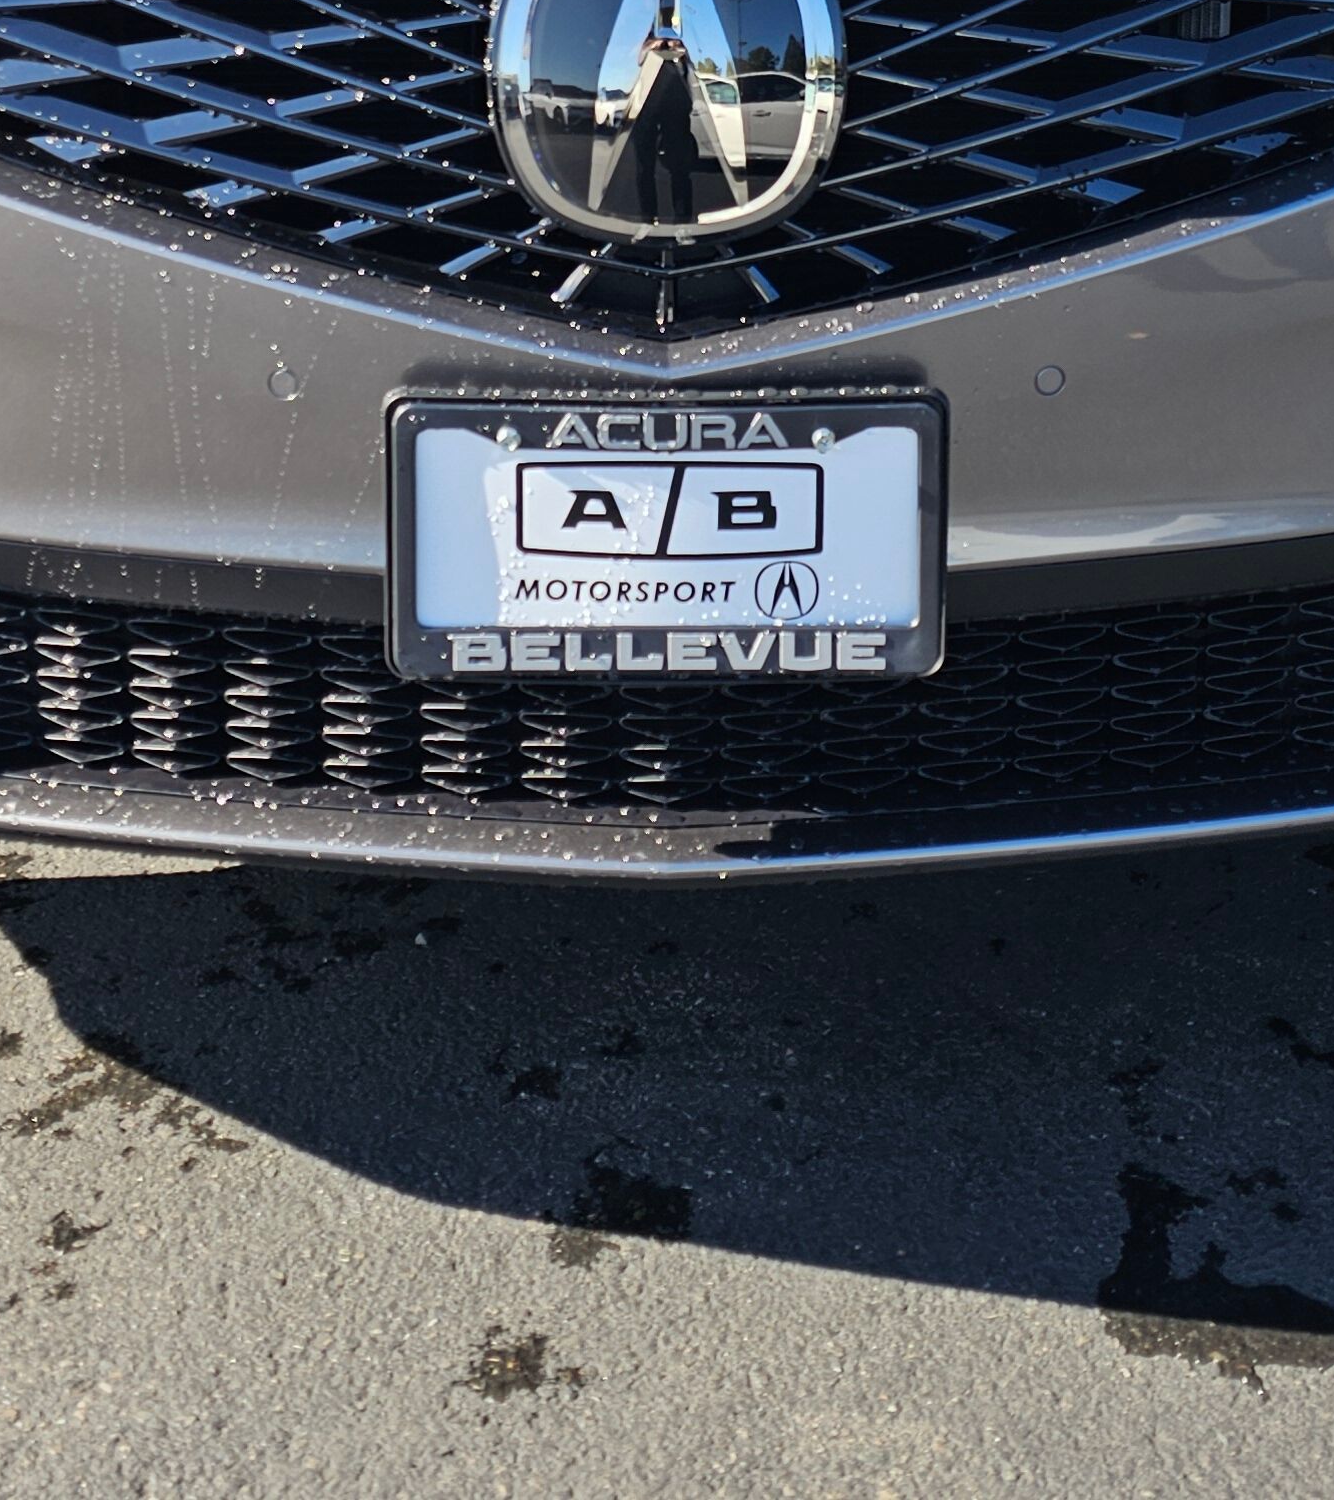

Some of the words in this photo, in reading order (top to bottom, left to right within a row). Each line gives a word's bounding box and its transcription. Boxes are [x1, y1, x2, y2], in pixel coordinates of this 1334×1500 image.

[548, 413, 789, 450] ACURA
[561, 490, 627, 529] A
[710, 491, 777, 530] B
[515, 579, 737, 603] MOTORSPORT
[447, 632, 887, 672] BELLEVUE
